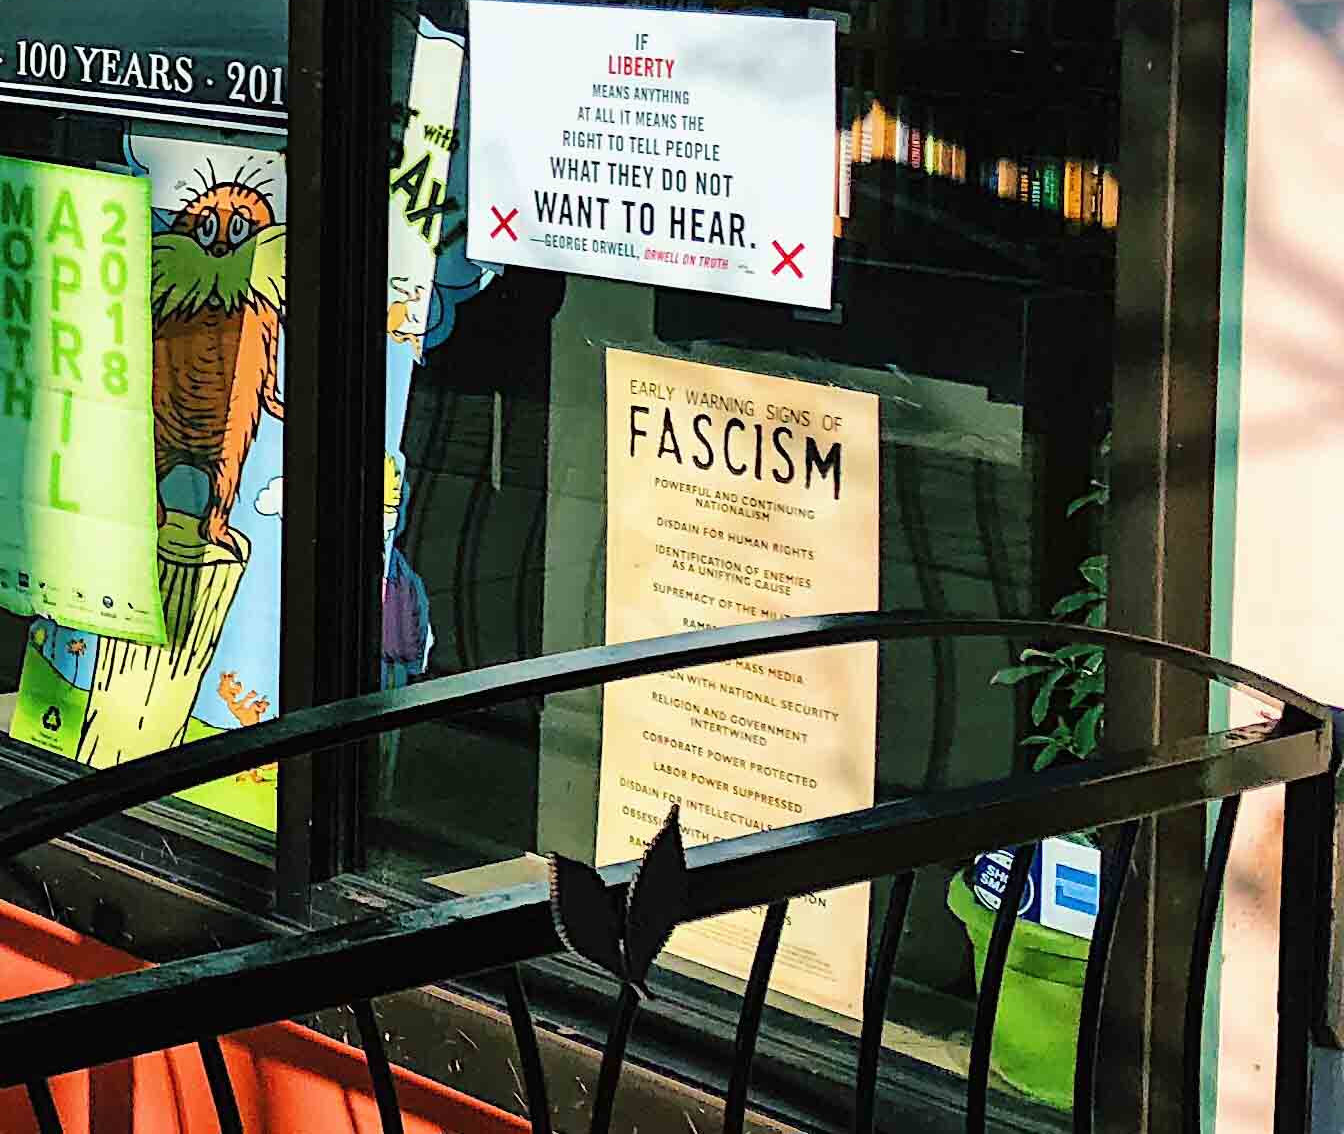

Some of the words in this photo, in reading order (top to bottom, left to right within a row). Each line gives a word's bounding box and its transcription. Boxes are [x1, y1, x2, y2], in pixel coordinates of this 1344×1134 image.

[635, 34, 649, 51] IF
[16, 40, 67, 80] 100
[73, 45, 194, 93] YEARS
[608, 55, 675, 79] LIBERTY
[592, 84, 630, 100] MEANS
[633, 87, 689, 105] ANYTHING
[577, 106, 591, 122] AT
[594, 107, 615, 124] ALL
[620, 110, 631, 126] IT
[636, 111, 677, 130] MEANS
[682, 115, 705, 132] THE
[562, 130, 603, 150] RIGHT
[608, 134, 624, 152] TO
[629, 136, 660, 156] TELL
[665, 140, 720, 162] PEOPLE
[550, 156, 600, 184] WHAT
[607, 162, 654, 189] THEY
[662, 168, 687, 193] DO
[696, 172, 733, 198] NOT
[534, 190, 609, 231] WANT
[622, 200, 655, 236] TO
[669, 205, 757, 250] HEAR.
[592, 238, 640, 260] ORWELL,
[644, 249, 680, 265] ORWELL
[682, 253, 696, 267] ON
[699, 255, 730, 270] TRUTH
[0, 181, 34, 421] MONTH
[46, 190, 85, 513] APRIL
[100, 201, 129, 395] 2018
[630, 379, 676, 401] EARLY
[686, 390, 755, 417] WARNING
[766, 404, 811, 427] SIGNS
[822, 414, 843, 432] OF
[630, 405, 842, 501] FASCISM
[655, 477, 711, 499] POWERFUL
[715, 490, 738, 503] AND
[742, 496, 816, 519] CONTINUING
[695, 498, 770, 522] NATIONALISM
[656, 516, 699, 534] DISDAIN
[703, 527, 724, 539] FOR
[727, 533, 769, 551] HUMAN
[772, 543, 814, 561] RIGHTS
[655, 544, 742, 573] IDENTIFICATION
[745, 565, 759, 576] OF
[763, 570, 812, 588] ENEMIES
[672, 559, 685, 571] AS
[687, 562, 695, 573] A
[698, 566, 751, 586] UNIFYING
[754, 580, 792, 596] CAUSE
[652, 582, 715, 605] SUPREMACY
[718, 598, 733, 609] OF
[735, 602, 756, 616] THE
[736, 660, 763, 675] MASS
[768, 667, 804, 685] MEDIA
[652, 691, 700, 714] RELIGION
[703, 707, 726, 721] AND
[730, 714, 808, 743] GOVERNMENT
[687, 673, 716, 691] WITH
[720, 683, 776, 707] NATIONAL
[781, 699, 840, 722] SECURITY
[690, 717, 767, 747] INTERTWINED
[642, 730, 704, 756] CORPORATE
[707, 749, 746, 768] POWER
[750, 762, 817, 789] PROTECTED
[619, 777, 659, 799] DISDAIN
[663, 791, 682, 805] FOR
[653, 762, 688, 779] LABOR
[691, 773, 729, 792] POWER
[732, 786, 803, 814] SUPPRESSED
[680, 826, 710, 843] WITH
